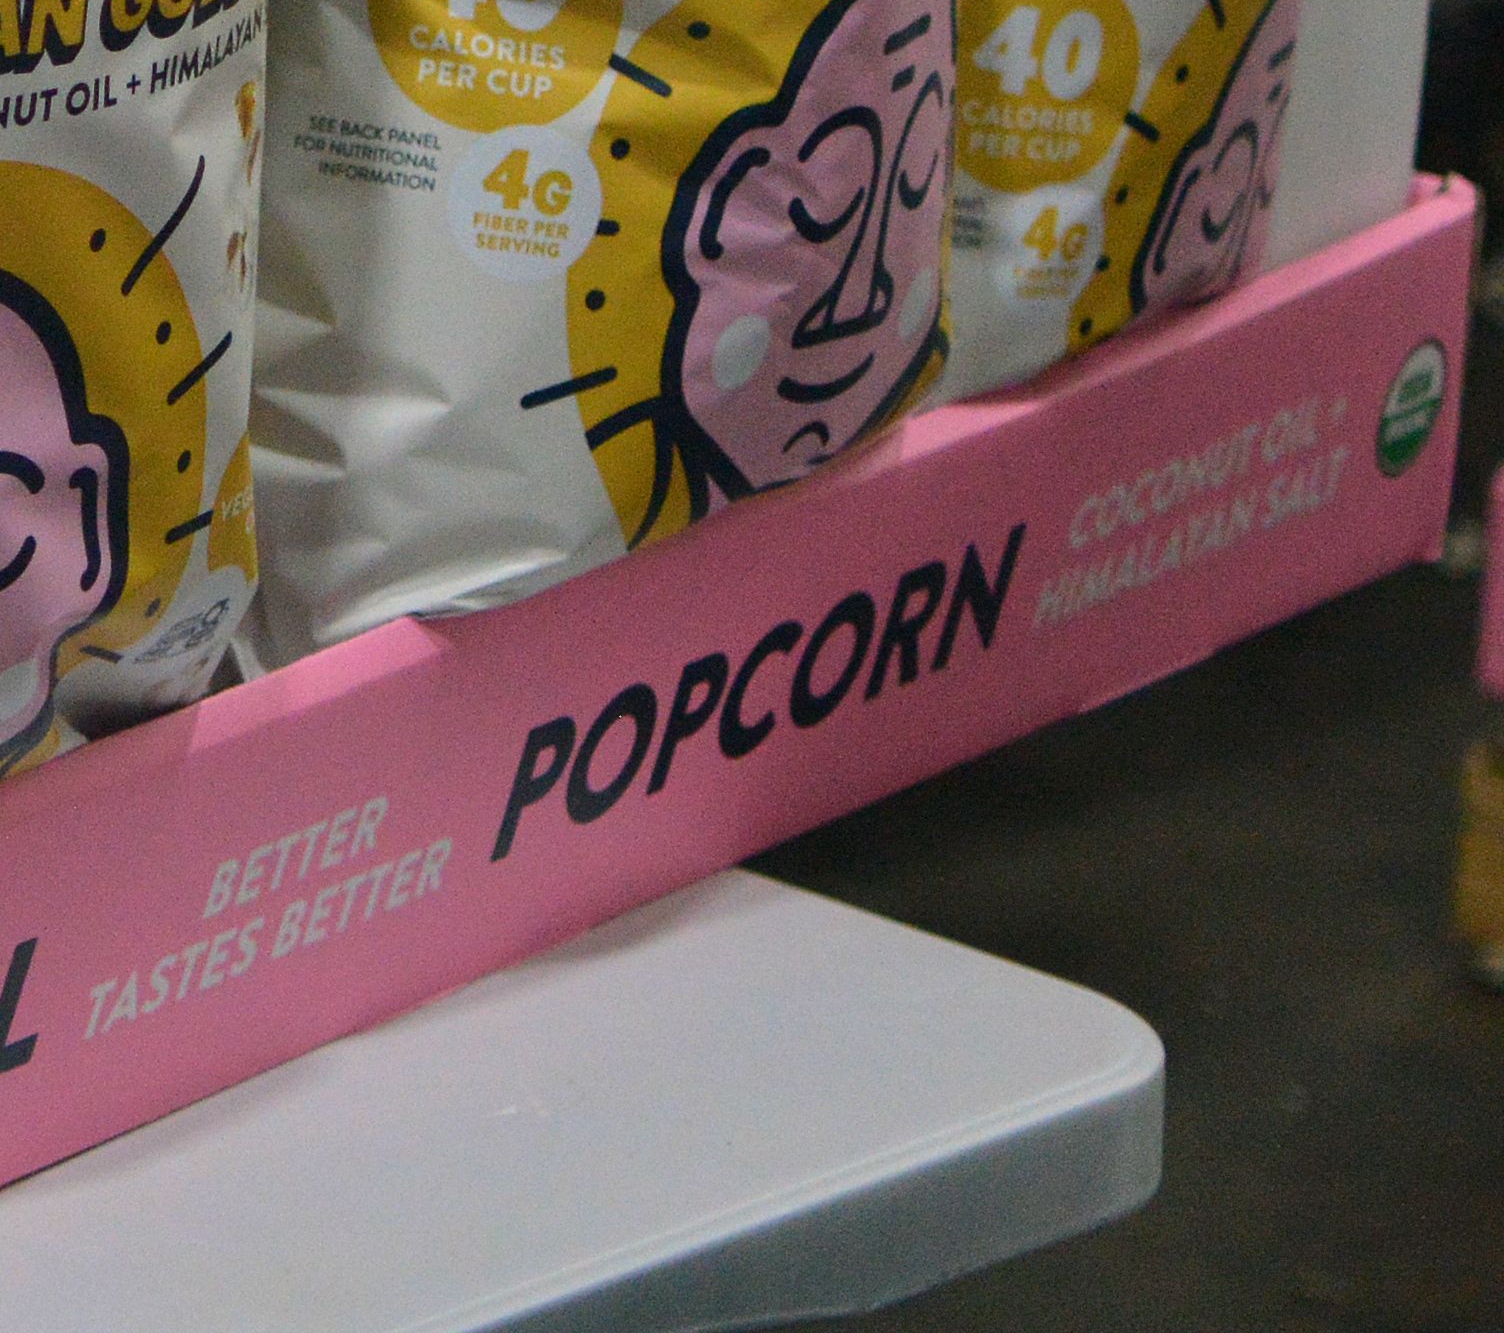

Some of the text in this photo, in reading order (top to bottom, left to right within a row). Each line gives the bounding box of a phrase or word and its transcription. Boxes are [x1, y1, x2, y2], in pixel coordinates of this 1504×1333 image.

[64, 75, 119, 117] OIL
[125, 73, 144, 96] +
[149, 10, 265, 97] HIMALAYAN
[408, 25, 567, 72] CALORIES
[972, 4, 1104, 101] 40
[417, 57, 554, 100] PER CUP
[309, 114, 442, 151] SEE BACK PANEL
[961, 100, 1096, 139] CALORIES
[293, 135, 439, 172] FOR NUTRITIONAL
[968, 133, 1082, 164] PER CUP
[317, 161, 437, 192] INFORMATION
[482, 147, 574, 217] 4G
[472, 211, 571, 240] FIBER PER
[475, 231, 561, 259] SERVING
[489, 521, 1028, 864] POPCORN
[202, 794, 391, 920] BETTER
[83, 836, 454, 1041] TASTES BETTER
